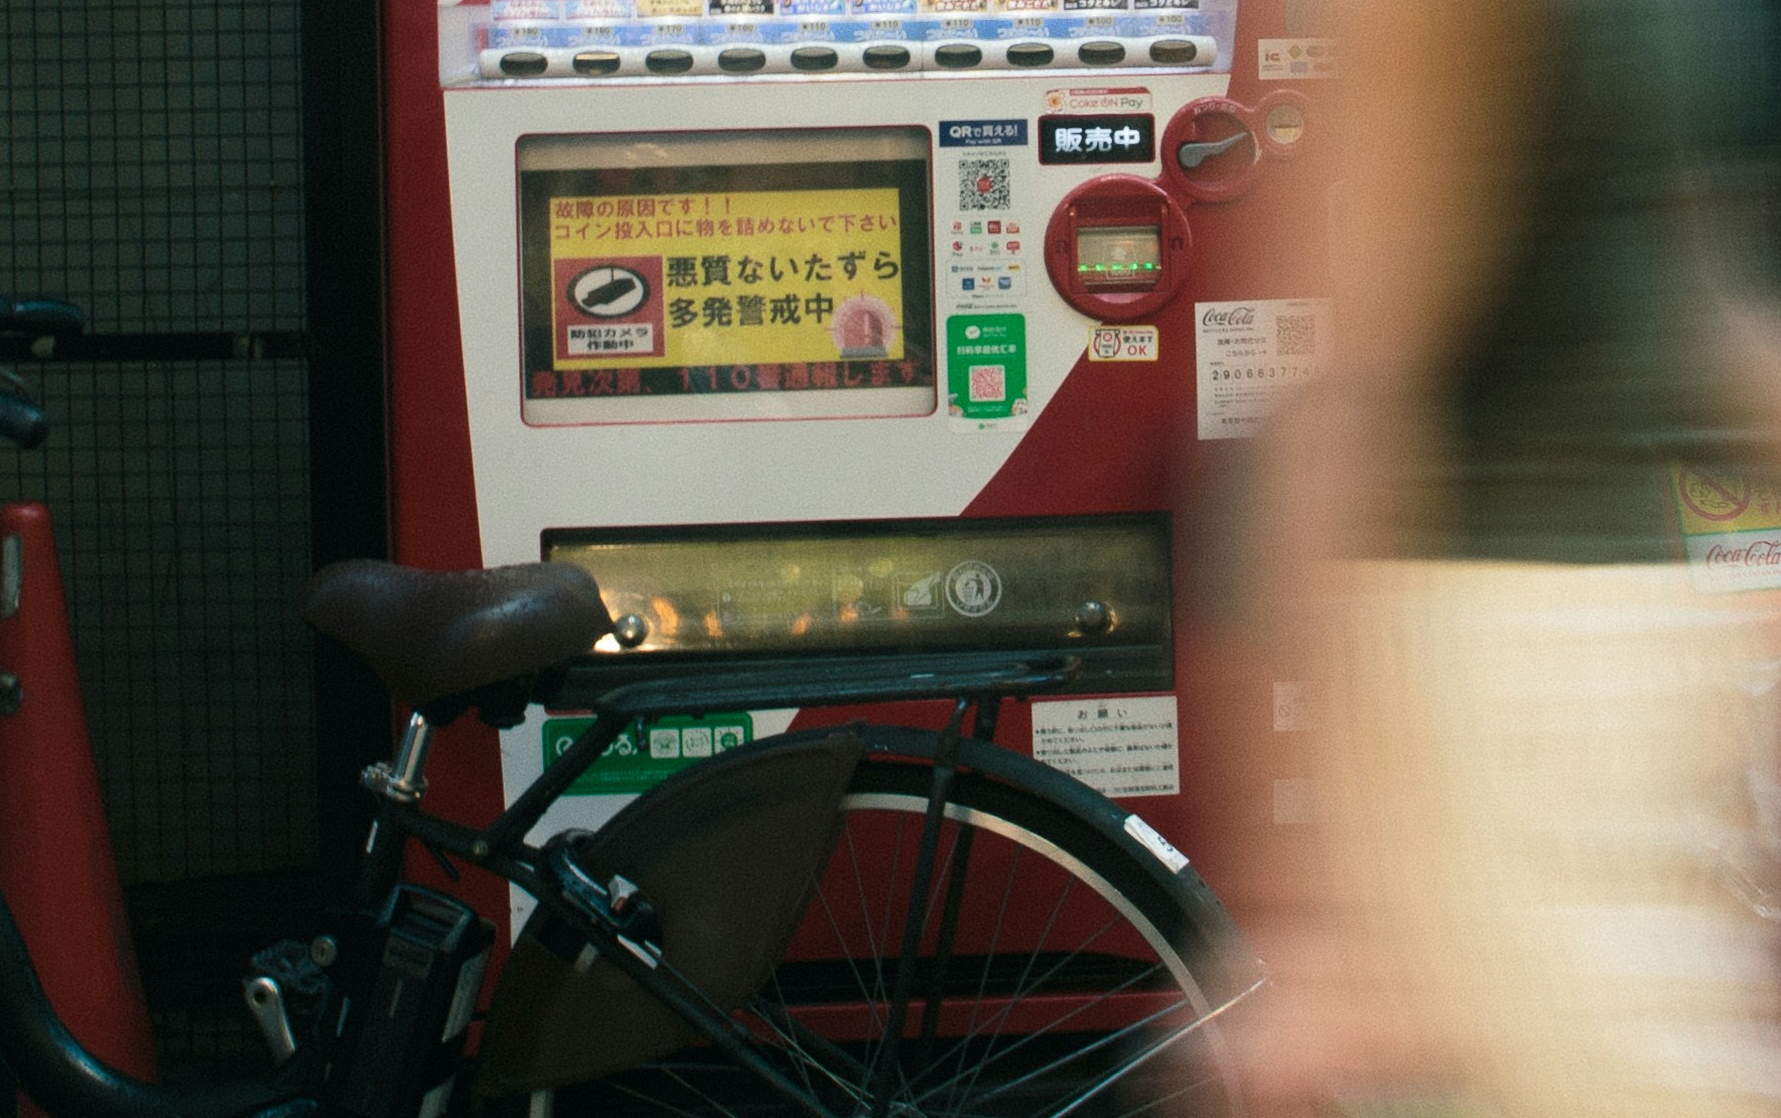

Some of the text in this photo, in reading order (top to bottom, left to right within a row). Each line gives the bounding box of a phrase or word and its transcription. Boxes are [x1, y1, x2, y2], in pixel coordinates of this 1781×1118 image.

[1069, 97, 1099, 109] Coke
[1120, 97, 1143, 110] Pay
[949, 123, 1018, 140] QRで買える!
[1054, 125, 1141, 152] 販売中
[555, 213, 898, 241] コイン投入口に物を詰めないで下さい
[668, 250, 899, 288] 悪質ないたずら
[669, 293, 834, 328] 多発警戒中
[1203, 307, 1255, 327] Coca-Cola
[570, 326, 648, 339] 防犯カメラ
[587, 338, 635, 351] 作動中
[1127, 344, 1147, 356] OK
